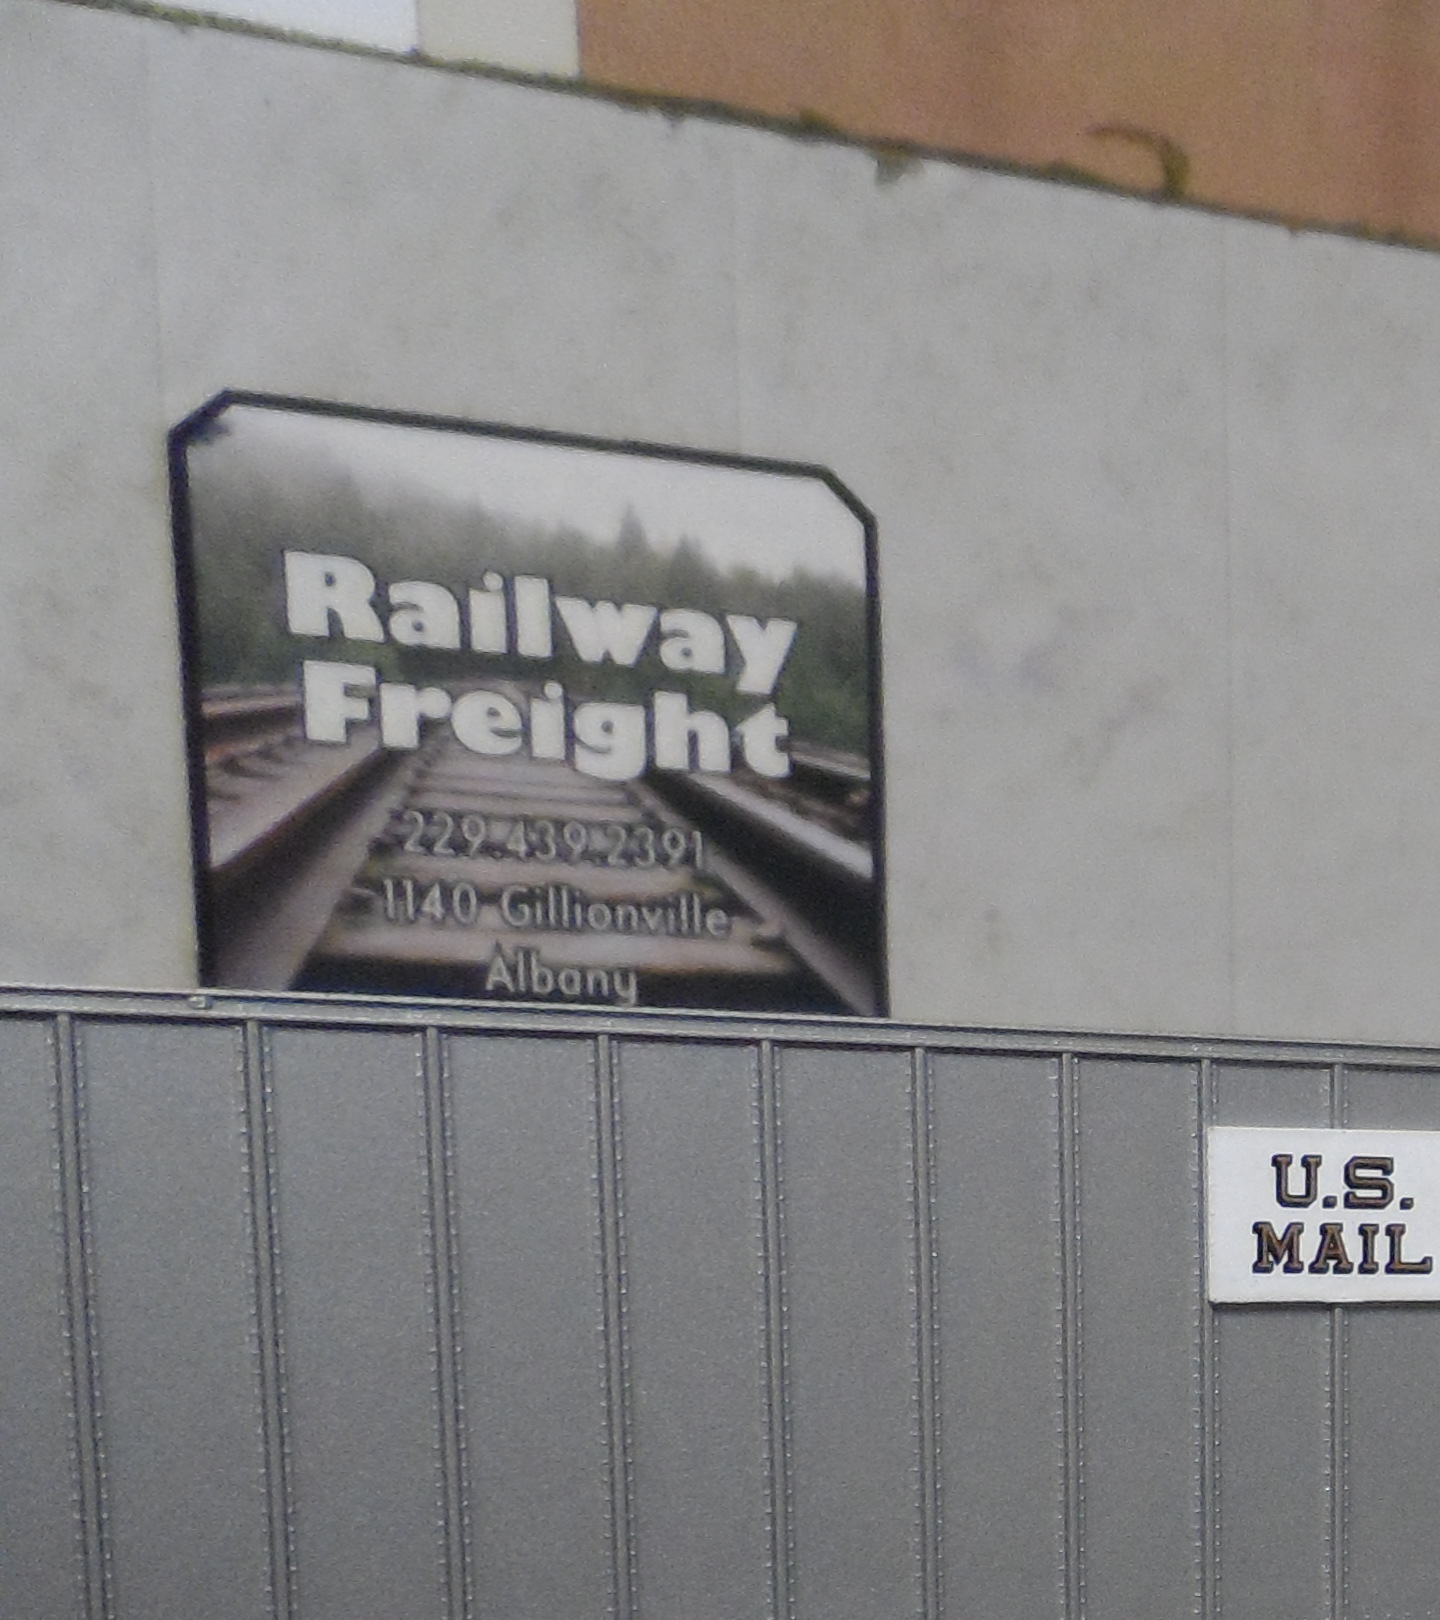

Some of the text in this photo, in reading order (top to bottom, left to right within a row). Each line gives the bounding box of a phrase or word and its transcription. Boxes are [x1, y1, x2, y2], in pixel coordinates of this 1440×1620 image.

[280, 549, 797, 696] Railway
[302, 659, 793, 780] Freight
[382, 877, 730, 938] 1140 Gillionville
[485, 945, 639, 1007] Albany
[1271, 1153, 1414, 1210] U.S.
[1252, 1221, 1433, 1274] MAIL
